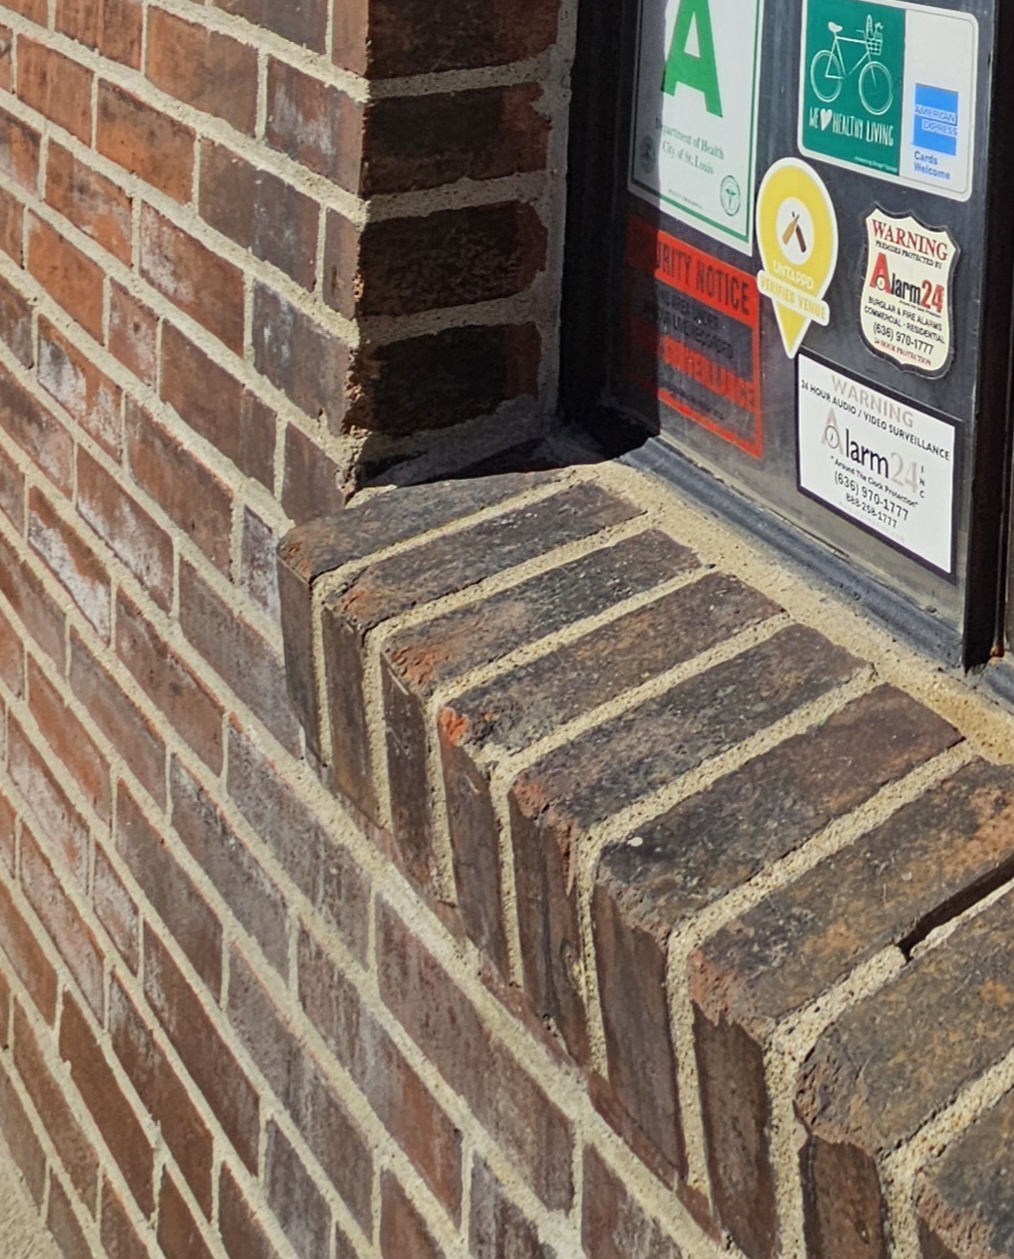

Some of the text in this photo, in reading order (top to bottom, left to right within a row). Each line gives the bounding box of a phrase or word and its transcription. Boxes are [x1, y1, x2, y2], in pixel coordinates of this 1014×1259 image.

[809, 107, 894, 147] WE HEALTHY LIVING
[914, 106, 958, 126] AMERICAN
[923, 120, 958, 136] EXPRESS
[662, 140, 714, 176] City Louis
[701, 138, 724, 160] Health
[913, 150, 938, 166] Cards
[913, 162, 951, 181] Welcome
[872, 219, 948, 261] WARNING
[901, 249, 934, 267] PROTECTED
[696, 259, 749, 316] NOTICE
[760, 277, 827, 320] VERIFIED VENUE
[869, 252, 945, 313] Alarm24
[864, 305, 902, 328] COMMERCIAL
[906, 323, 945, 344] RESIDENTIAL
[868, 296, 897, 315] BURGLAR
[902, 309, 916, 322] FIRE
[917, 313, 943, 332] ALARMS
[873, 321, 934, 355] (636) 970-1777
[801, 379, 951, 461] 24 HOUR AUDIO VIDEO SURVEILLANCE
[832, 374, 914, 429] WARNING
[820, 407, 919, 493] Alarm24
[856, 469, 868, 482] The
[834, 470, 909, 521] (636) 970-1777
